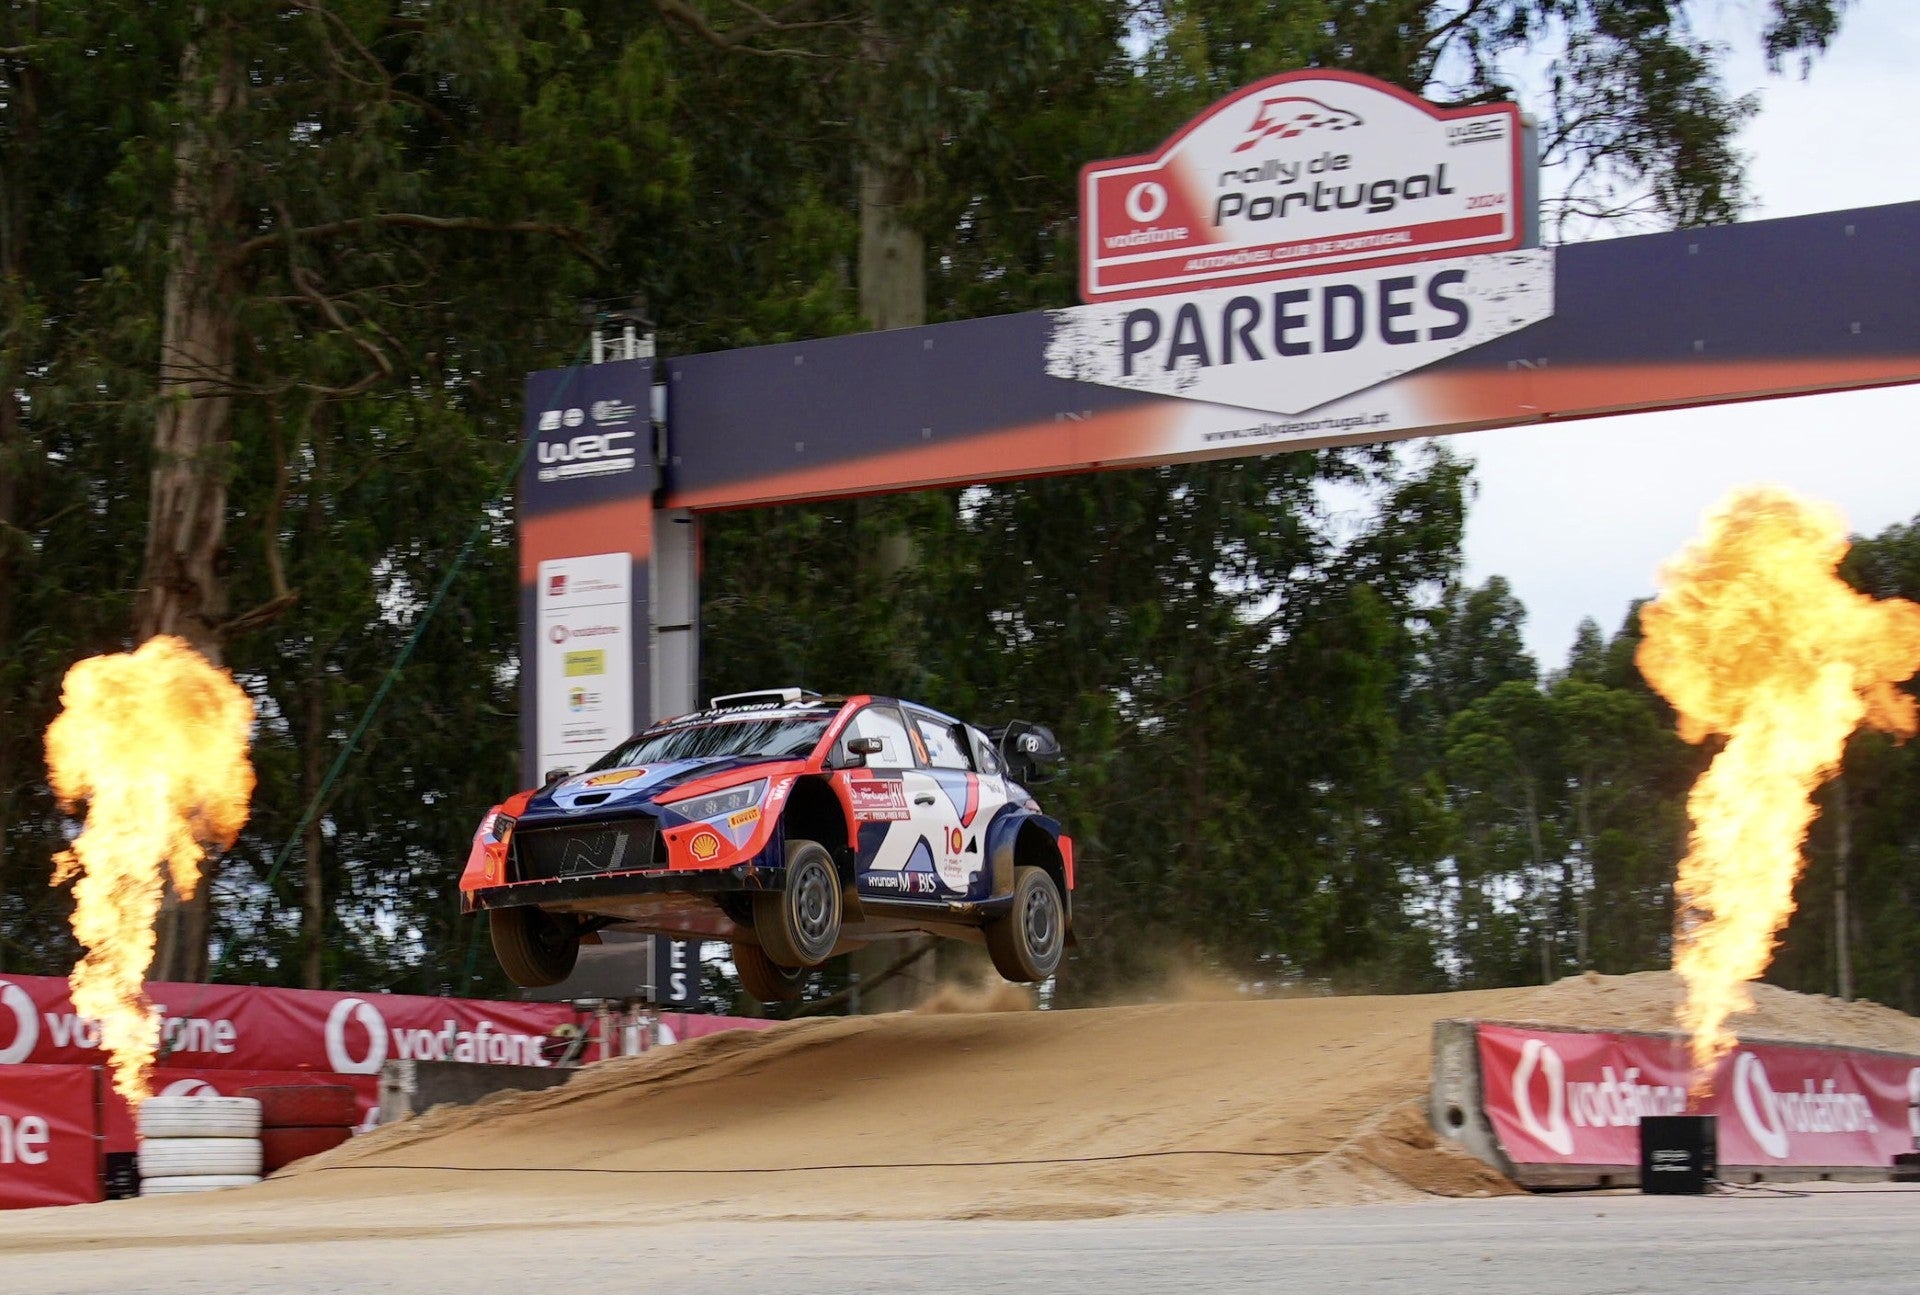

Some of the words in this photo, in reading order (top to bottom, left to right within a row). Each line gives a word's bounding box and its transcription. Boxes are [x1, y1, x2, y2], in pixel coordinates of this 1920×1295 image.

[1219, 158, 1300, 187] rally
[1306, 151, 1352, 174] de
[1213, 163, 1455, 227] Portugal
[1104, 226, 1189, 249] vodafone
[1122, 270, 1470, 377] PAREDES
[1202, 413, 1390, 441] www.rallydeportugal.pt
[868, 876, 899, 888] HYUNDAI
